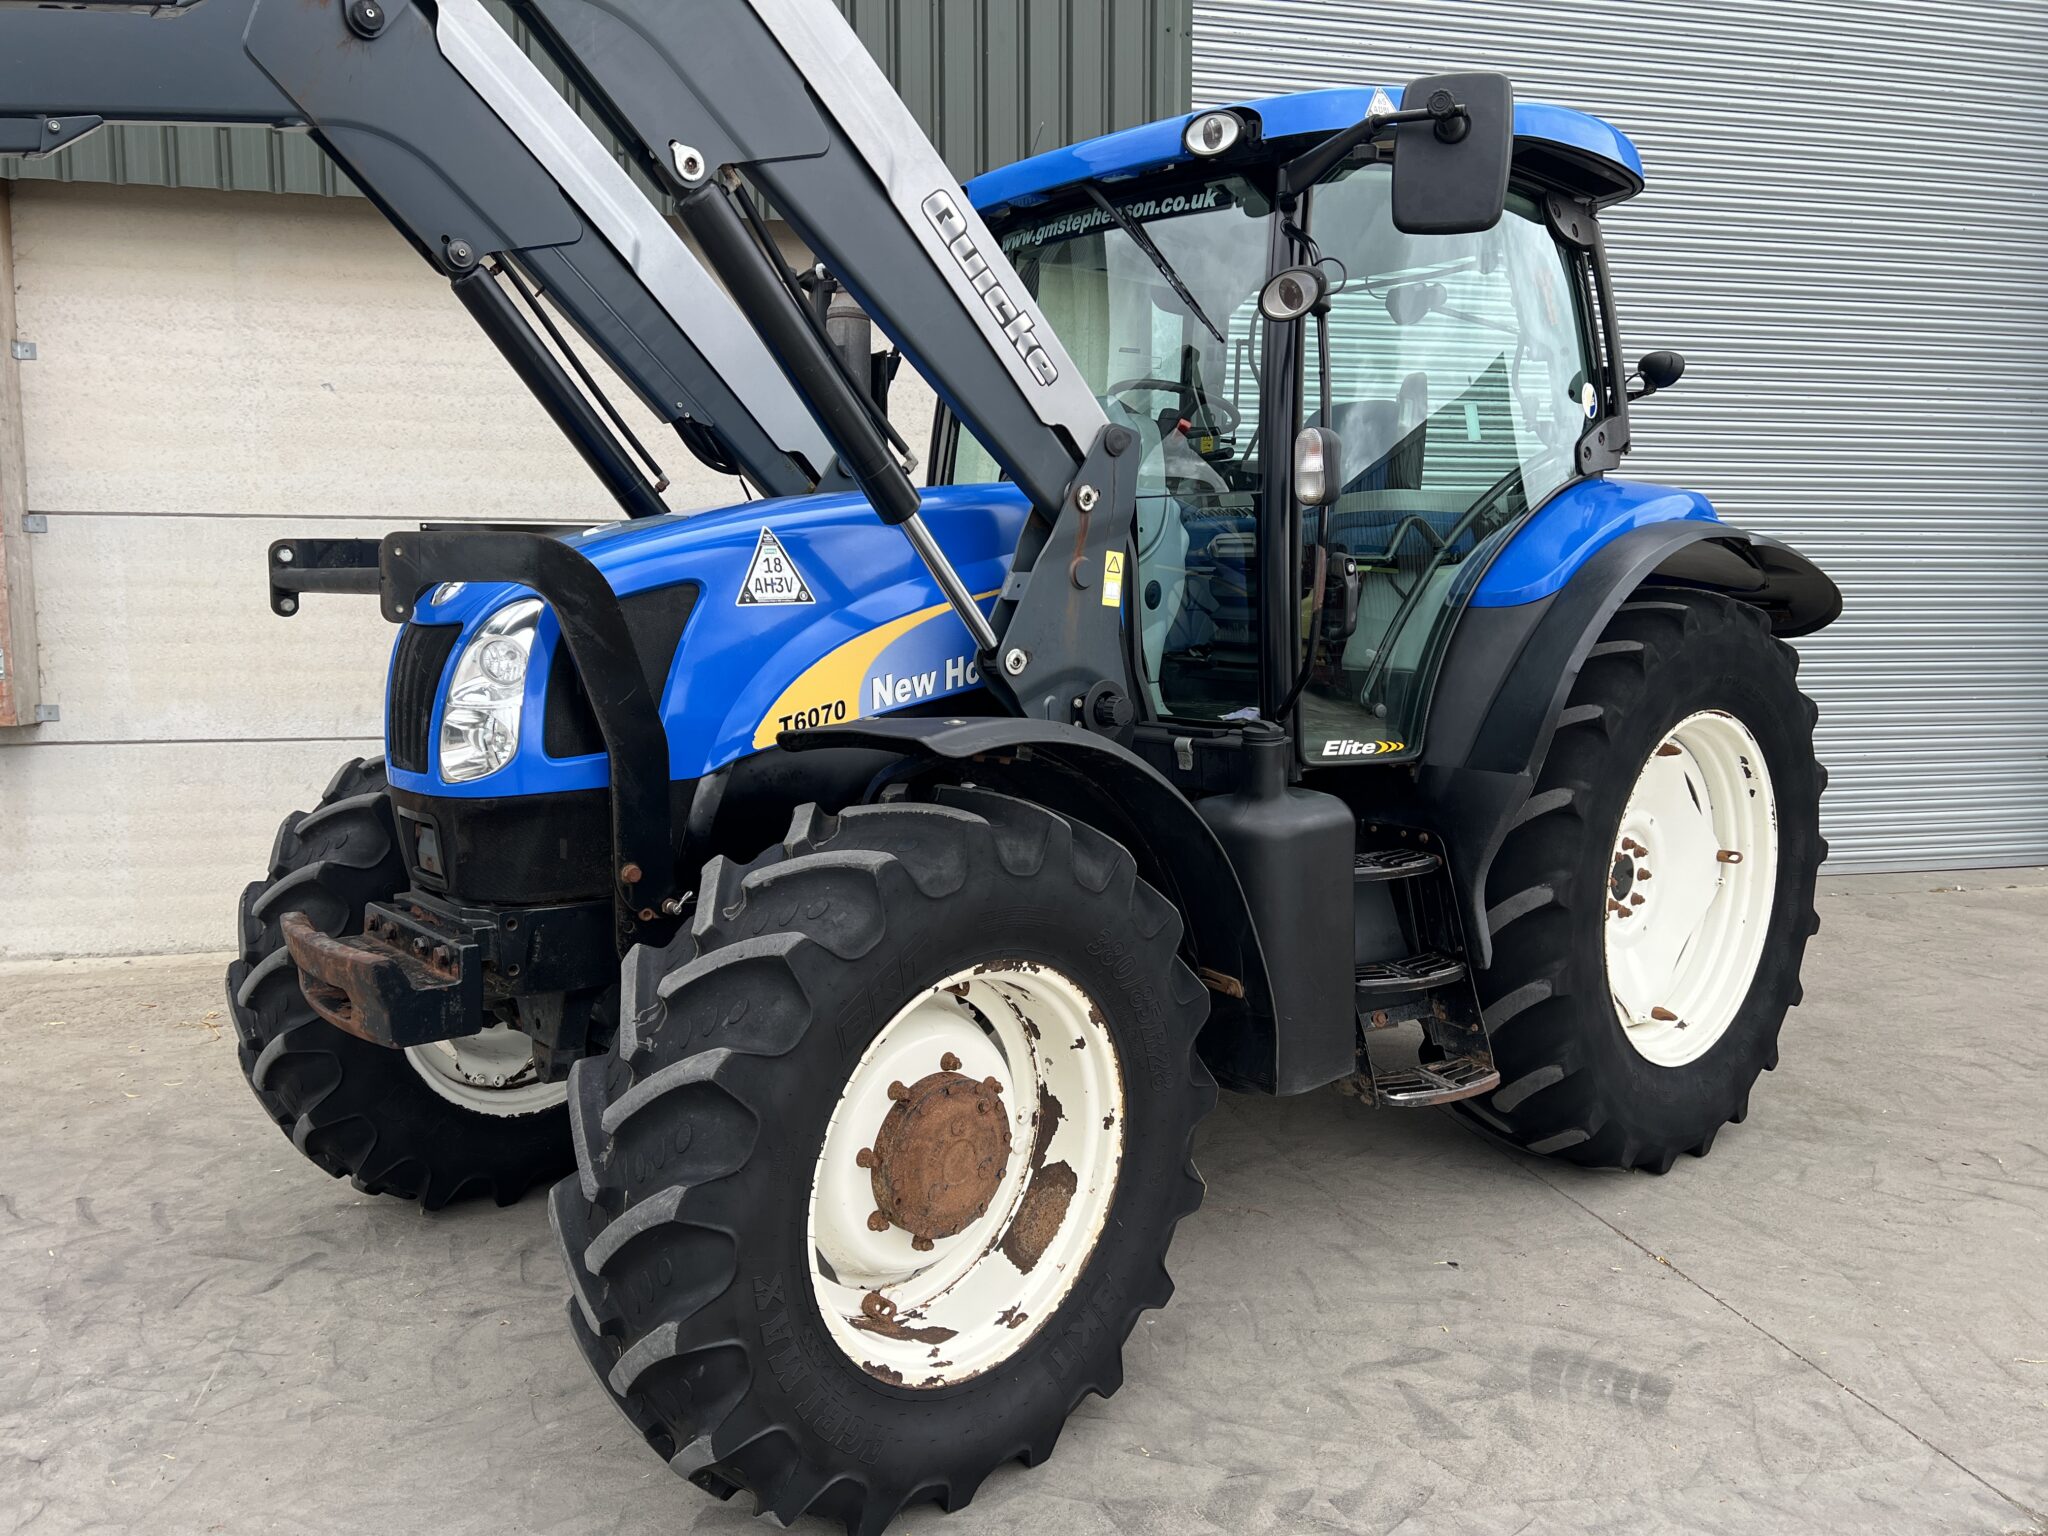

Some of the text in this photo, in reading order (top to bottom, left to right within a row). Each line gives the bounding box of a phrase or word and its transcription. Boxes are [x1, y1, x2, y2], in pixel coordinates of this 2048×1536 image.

[922, 189, 1058, 387] Quicke
[762, 557, 783, 574] 18
[754, 577, 794, 594] AH3V
[871, 670, 937, 710] New
[778, 699, 846, 731] T6070
[1321, 740, 1377, 756] Elite
